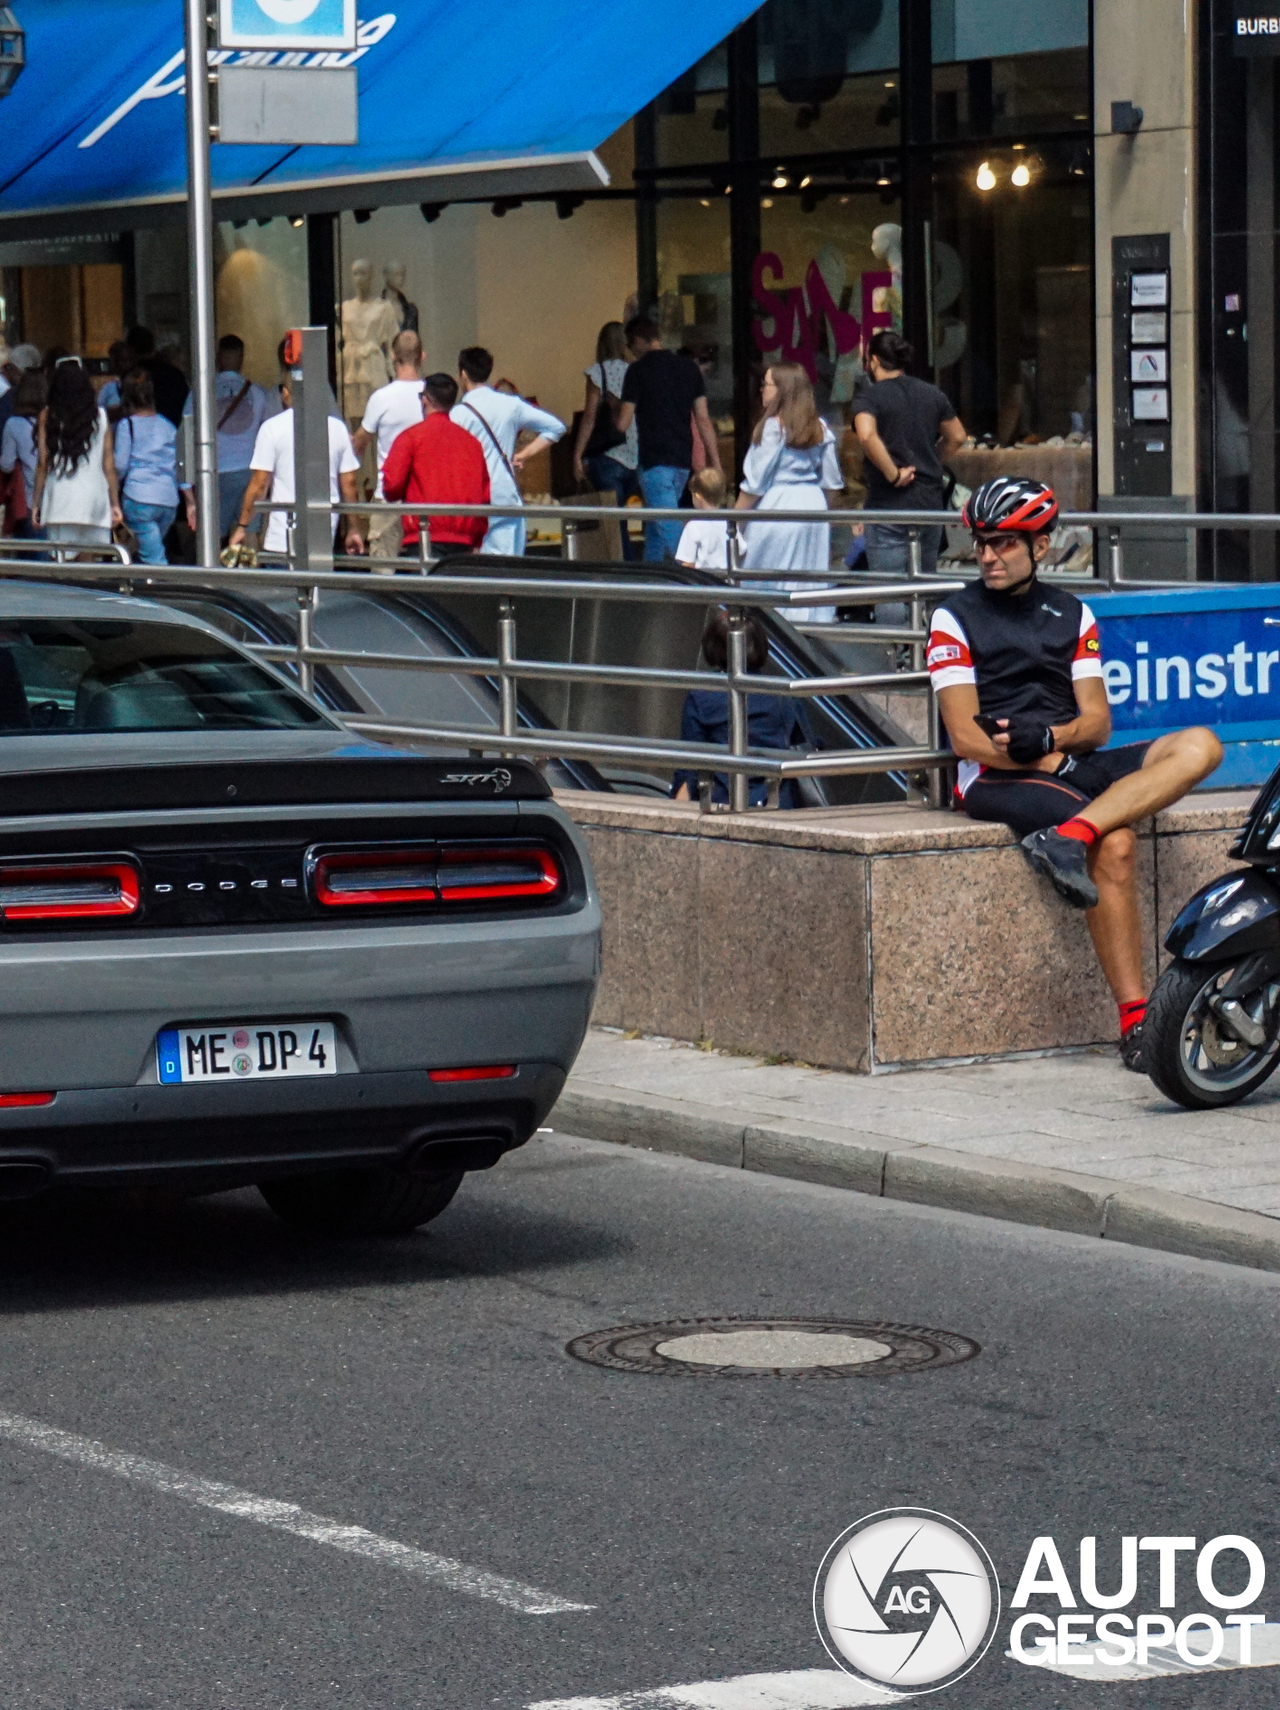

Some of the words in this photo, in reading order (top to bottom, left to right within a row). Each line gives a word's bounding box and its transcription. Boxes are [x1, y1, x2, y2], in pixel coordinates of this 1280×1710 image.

[439, 773, 497, 786] SRT
[154, 878, 298, 893] DODGE
[166, 1061, 176, 1074] D
[185, 1033, 231, 1075] ME
[255, 1029, 299, 1072] DP
[308, 1028, 327, 1069] 4
